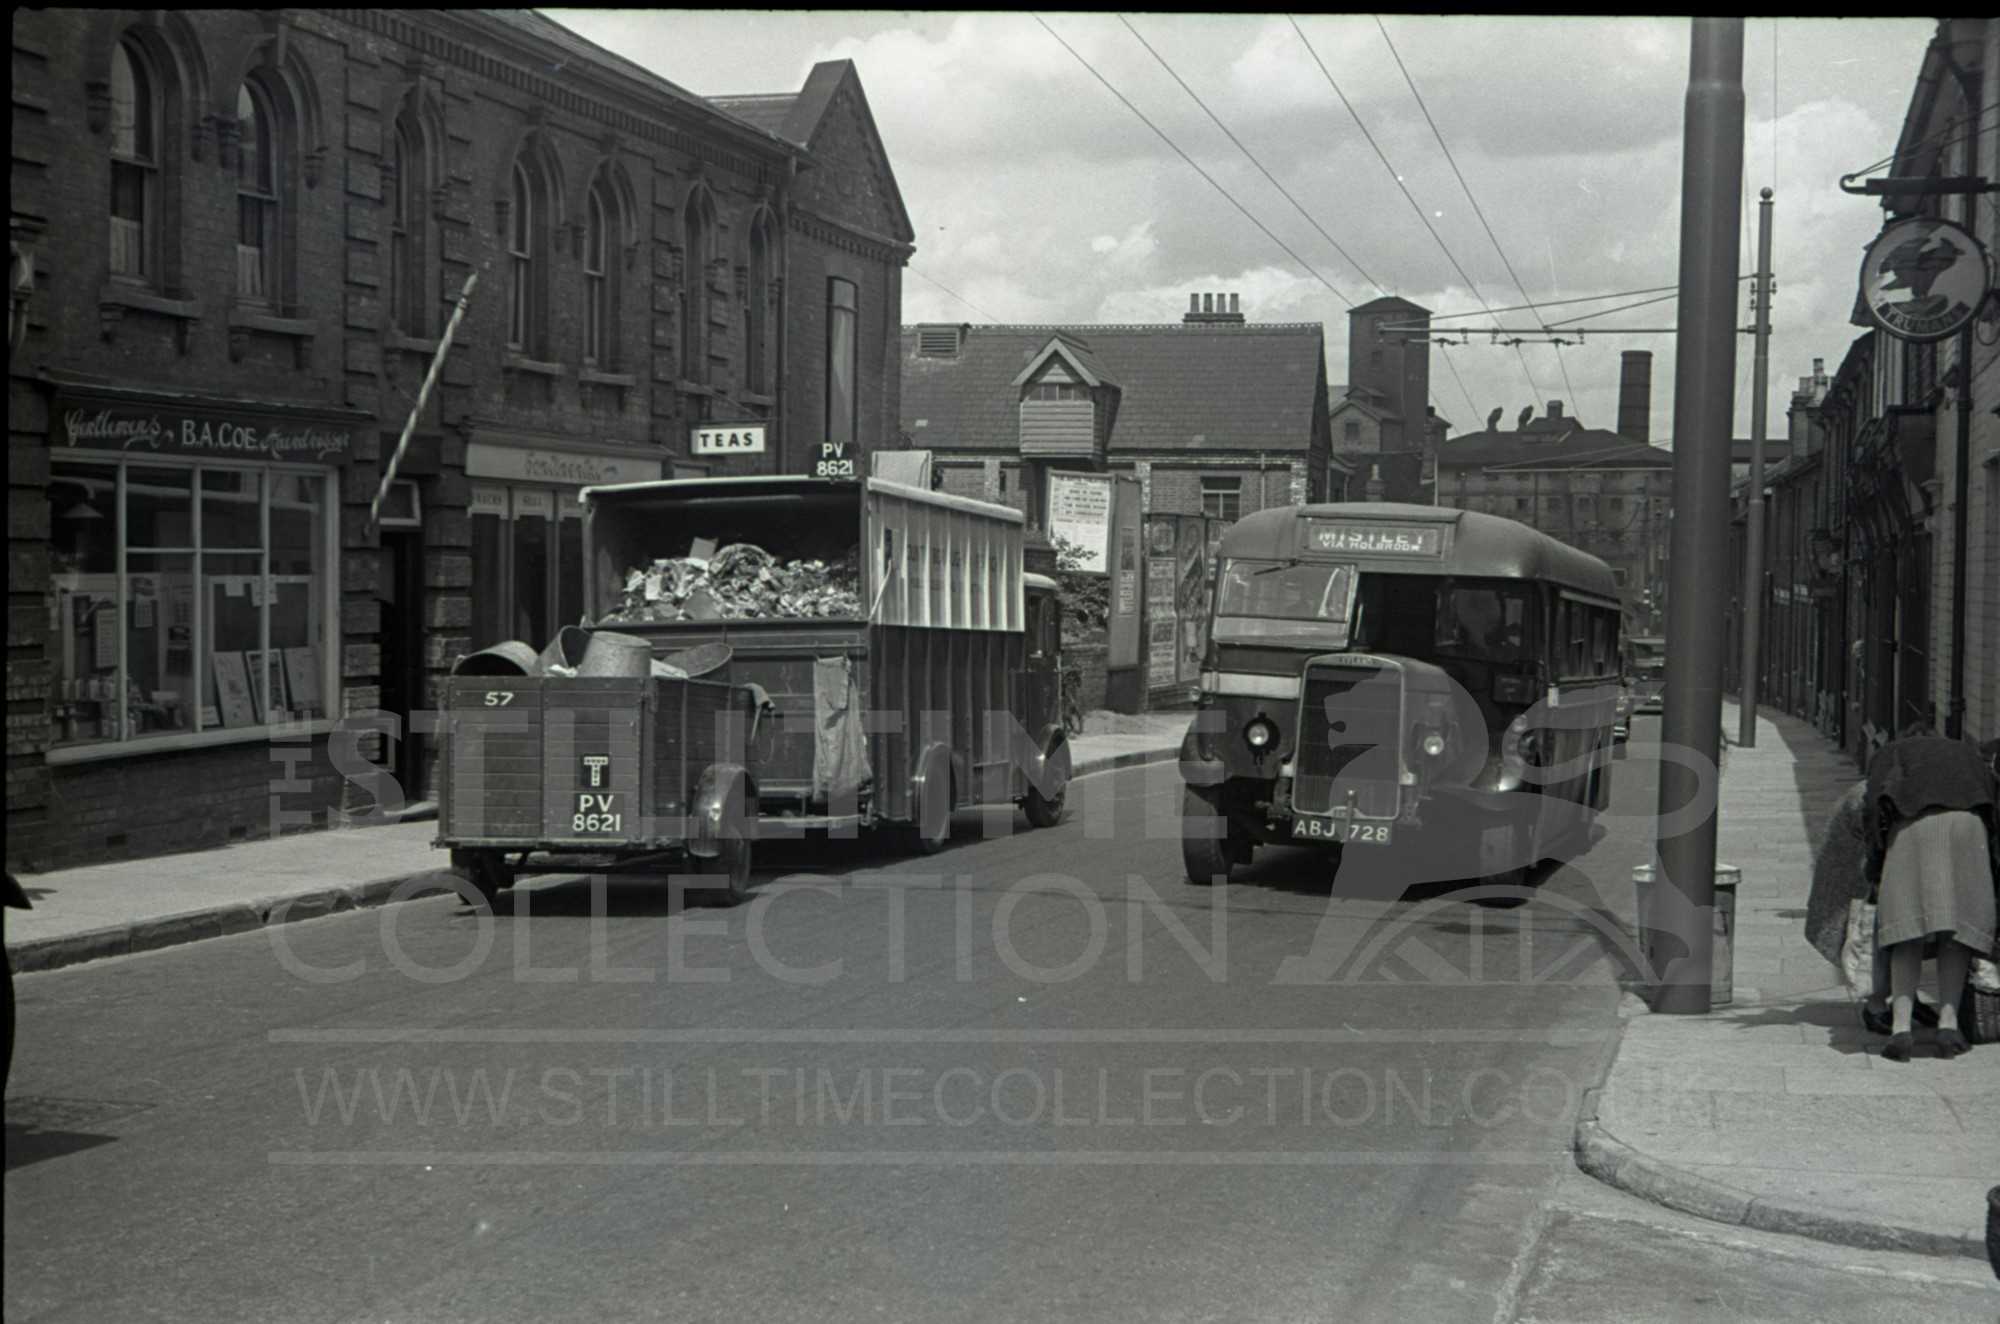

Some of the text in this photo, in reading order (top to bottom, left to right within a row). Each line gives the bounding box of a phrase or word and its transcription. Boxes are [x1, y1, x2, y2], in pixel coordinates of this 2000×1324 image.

[700, 433, 754, 448] TEAS
[822, 443, 845, 458] PV
[816, 460, 853, 476] 8621
[1322, 541, 1344, 550] VIA
[484, 692, 514, 706] 57
[584, 756, 608, 786] T
[579, 795, 614, 812] PV
[572, 814, 621, 832] 8621
[1294, 820, 1389, 842] ABJ 728
